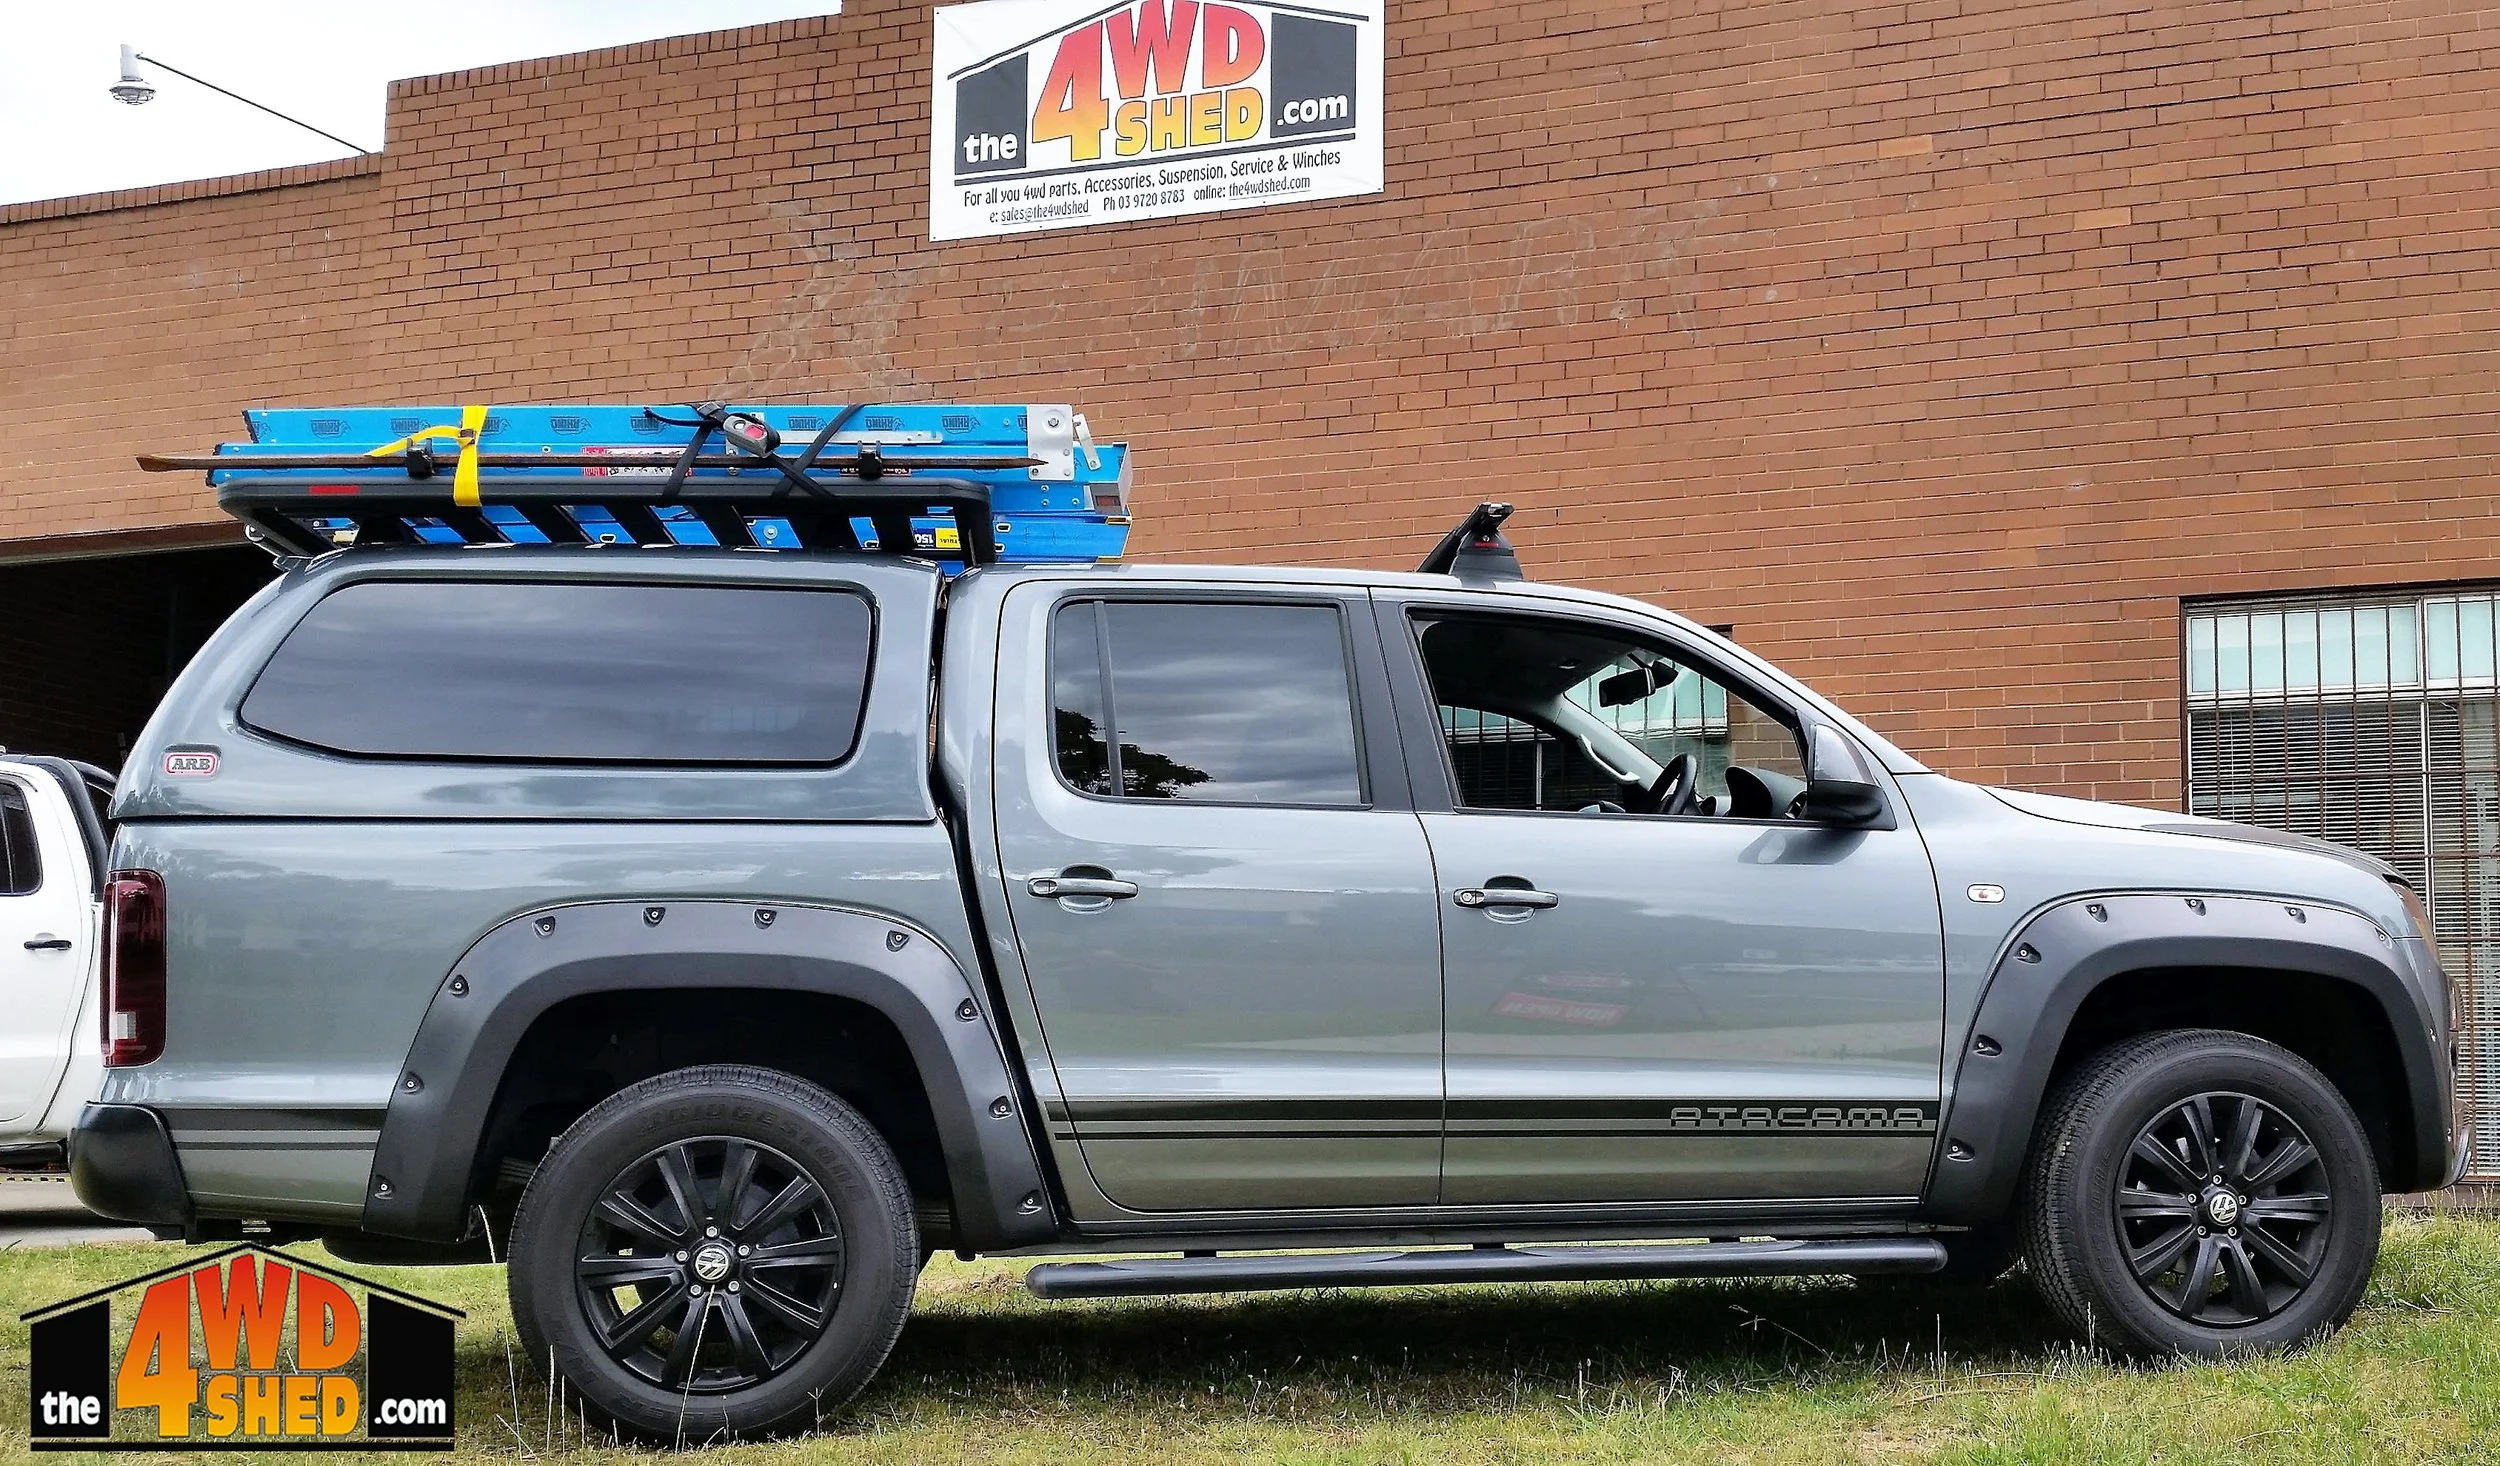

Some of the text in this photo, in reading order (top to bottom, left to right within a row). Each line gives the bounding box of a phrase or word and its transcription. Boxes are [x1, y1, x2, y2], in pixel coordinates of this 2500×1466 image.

[1032, 0, 1265, 163] 4WD
[962, 88, 1349, 164] the SHED .com
[964, 190, 982, 207] For
[985, 187, 998, 204] all
[1000, 188, 1020, 203] you
[1023, 182, 1046, 201] 4wd
[1230, 158, 1274, 177] Service
[1277, 154, 1289, 171] &
[1292, 149, 1341, 169] Winches
[989, 176, 1311, 223] e: sales@the4wdshed Ph 03 9720 8783 online: the4wdshed.com
[171, 758, 211, 771] ARB
[1670, 1107, 1924, 1128] ATACAMA
